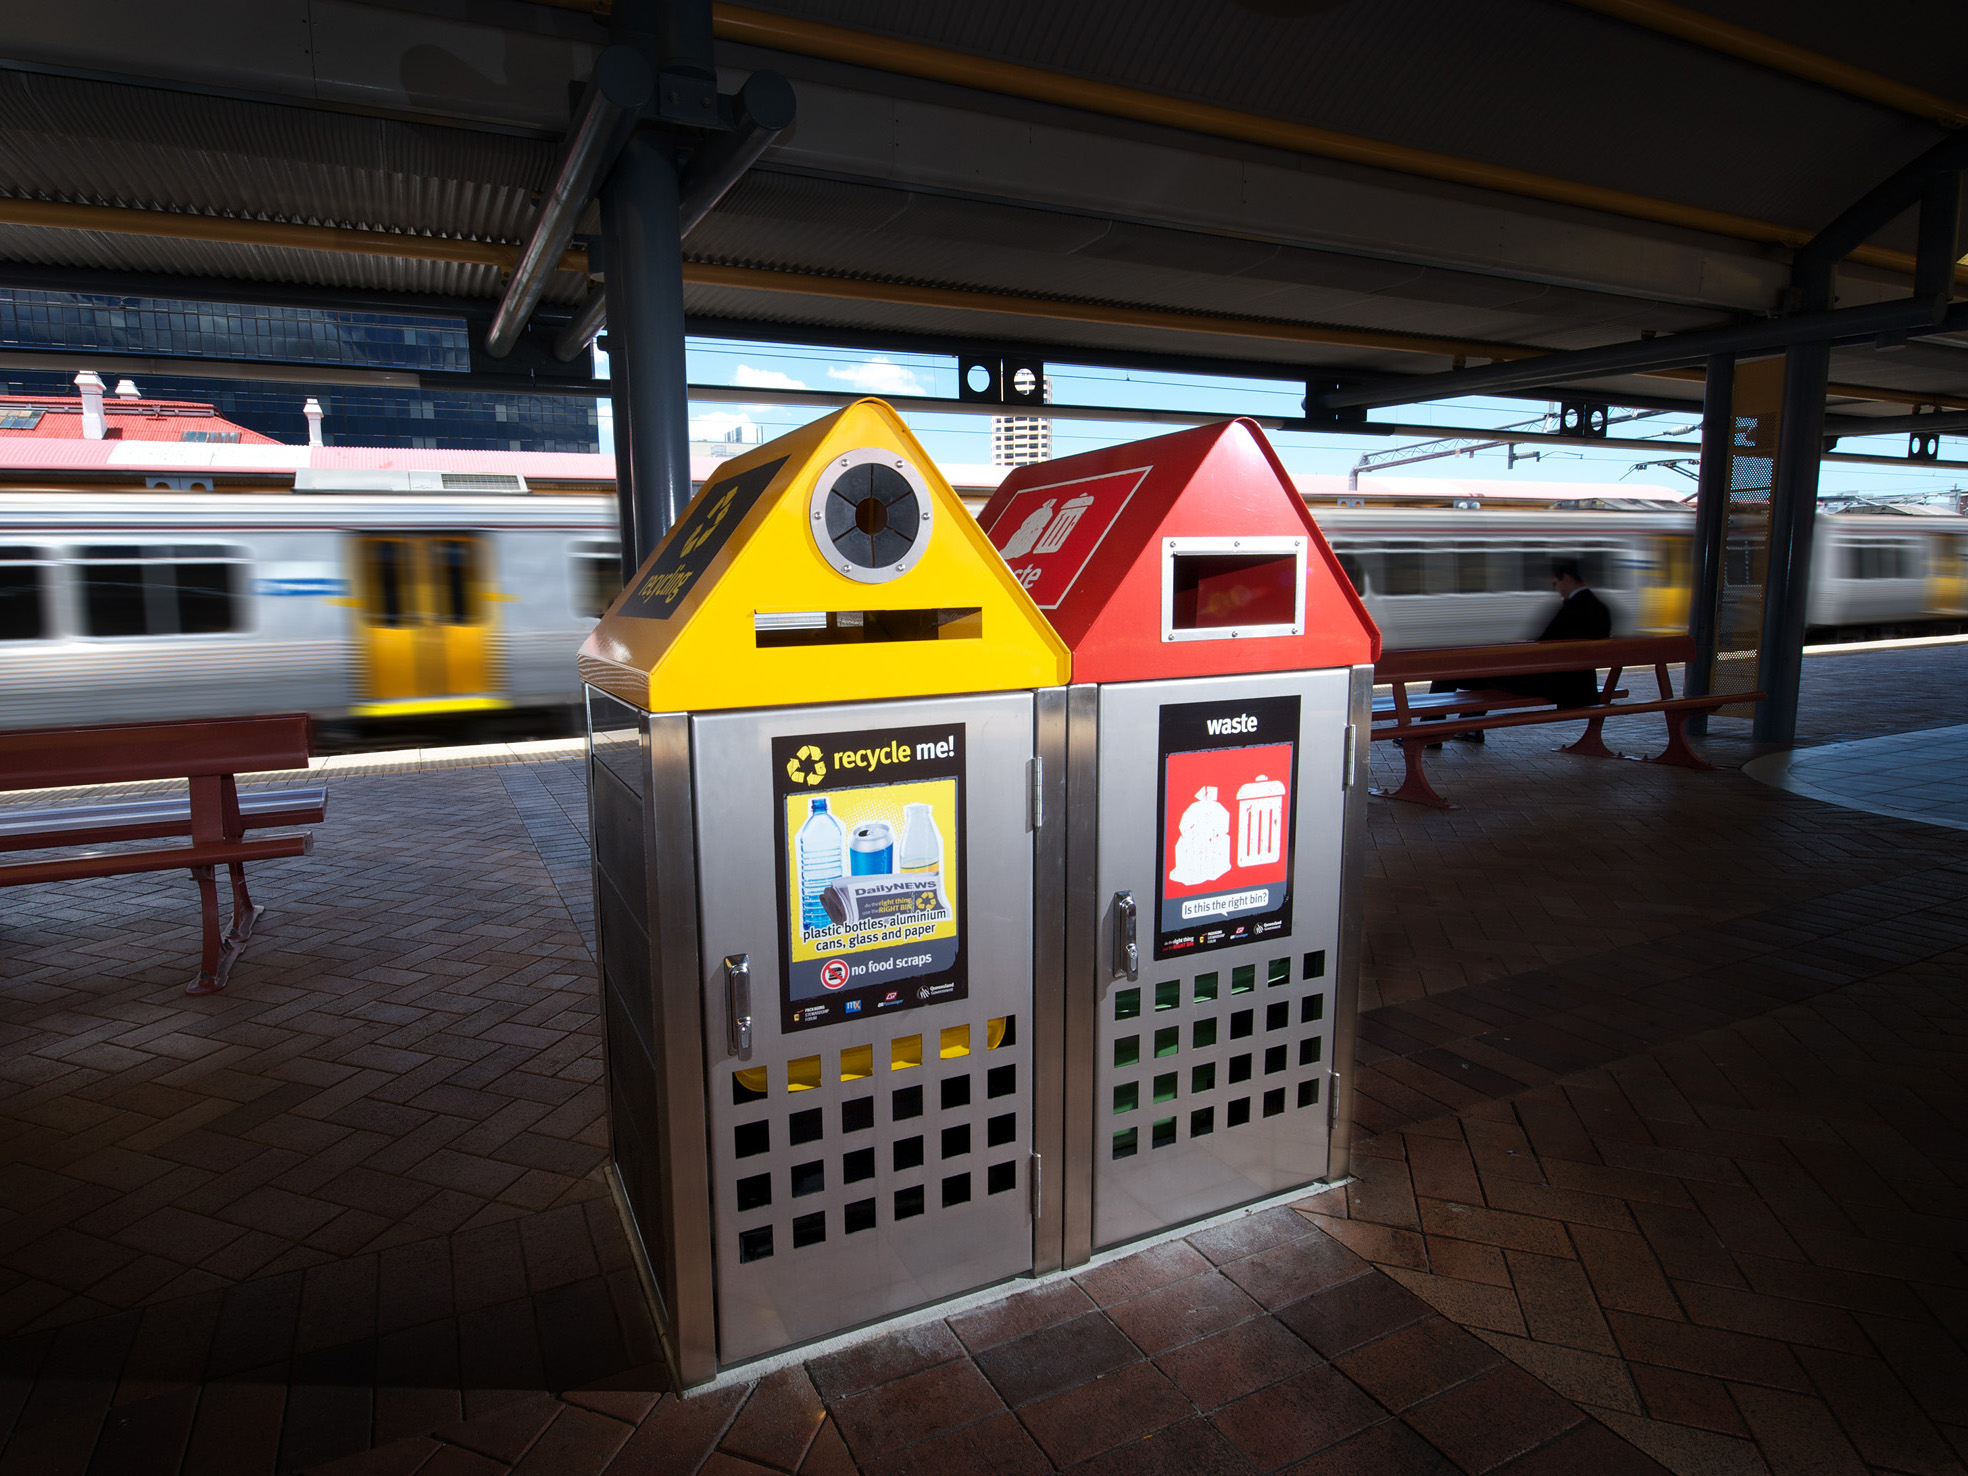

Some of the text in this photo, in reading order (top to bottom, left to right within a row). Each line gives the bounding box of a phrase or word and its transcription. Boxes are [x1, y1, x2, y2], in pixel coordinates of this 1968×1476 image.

[638, 564, 694, 604] recycling
[1206, 713, 1258, 736] waste
[834, 735, 955, 772] recycle me!
[855, 881, 937, 896] DailyNEWS
[879, 899, 895, 907] right
[895, 897, 912, 905] thing
[879, 905, 899, 913] RIGHT
[1184, 892, 1267, 915] Is this the right bin?
[803, 910, 946, 942] plastic bottles, aluminium
[816, 924, 936, 951] cans, glass and paper
[851, 953, 932, 976] no food scraps
